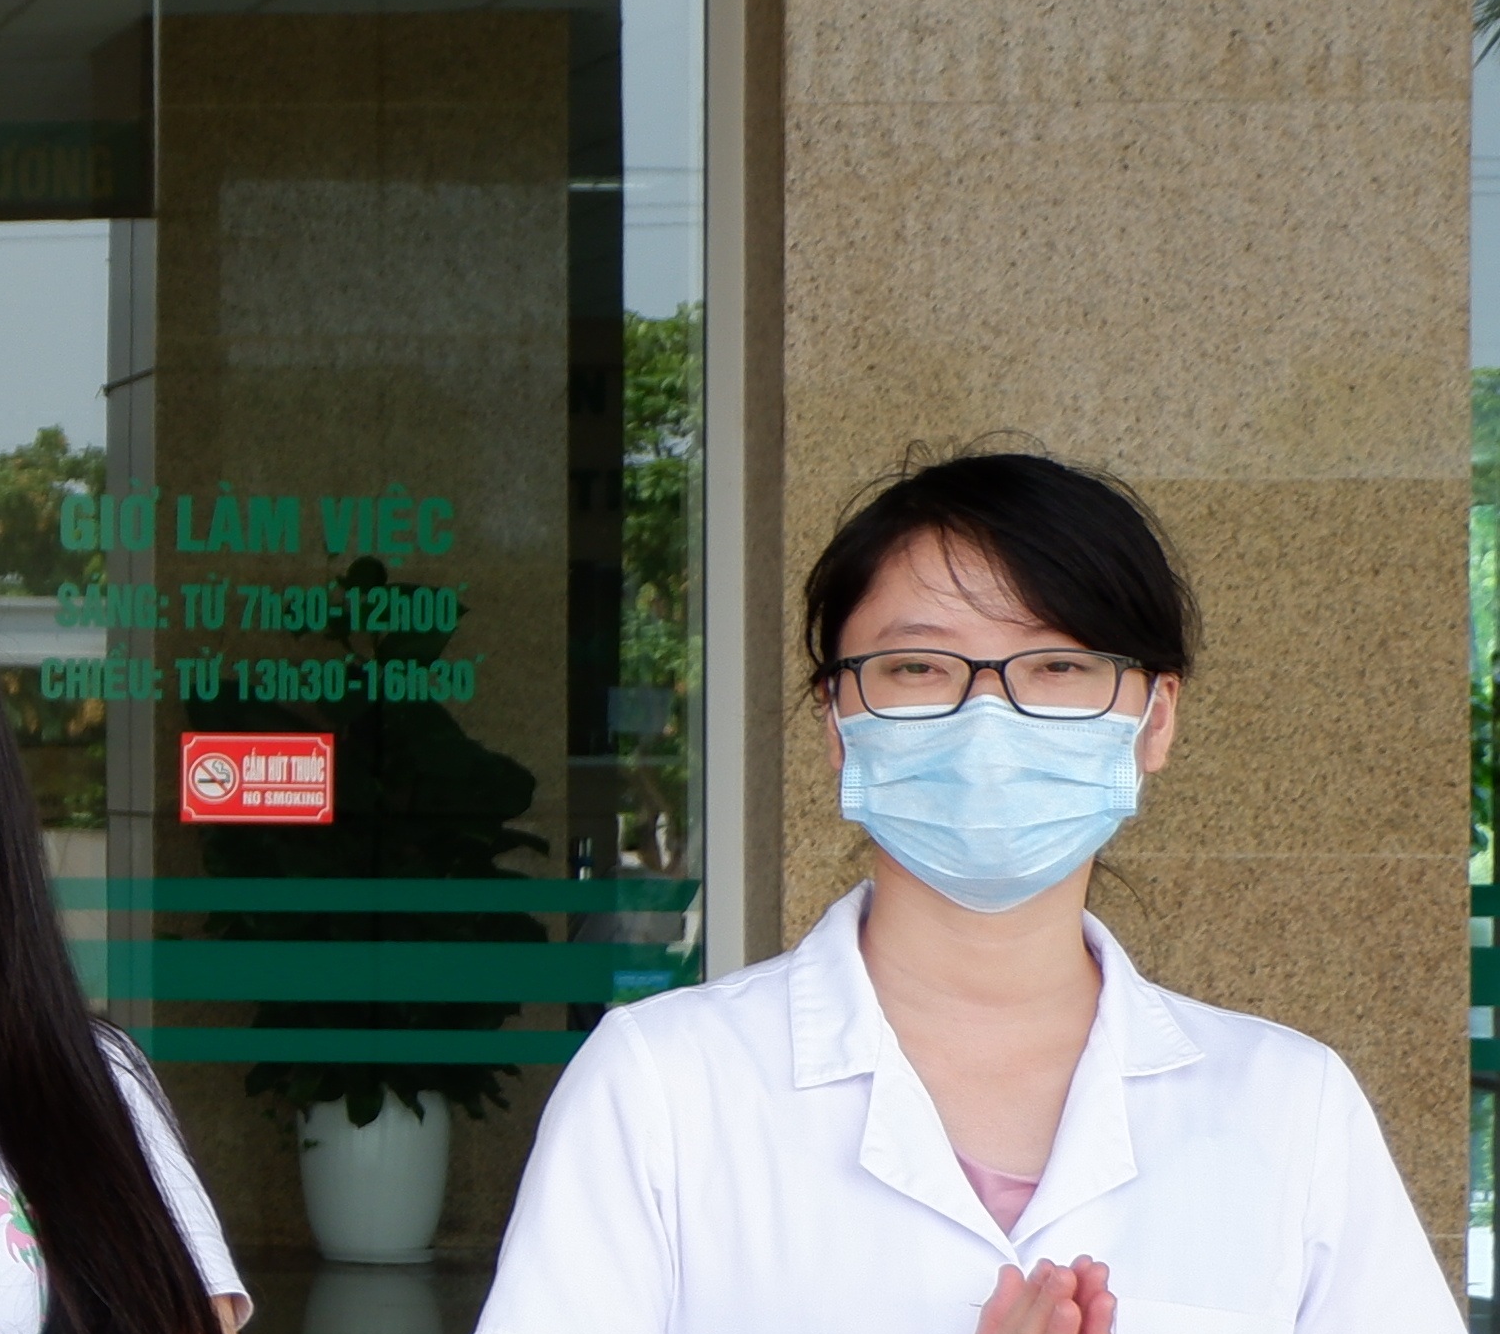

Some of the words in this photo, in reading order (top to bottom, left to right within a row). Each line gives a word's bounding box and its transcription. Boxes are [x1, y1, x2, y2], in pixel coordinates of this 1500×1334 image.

[60, 478, 160, 552] GIỜ
[175, 480, 301, 554] LÀM
[319, 481, 455, 567] VIỆC
[180, 572, 229, 631] TỪ
[174, 646, 225, 702] TỪ
[242, 791, 261, 806] NO
[264, 791, 325, 806] SMOKING
